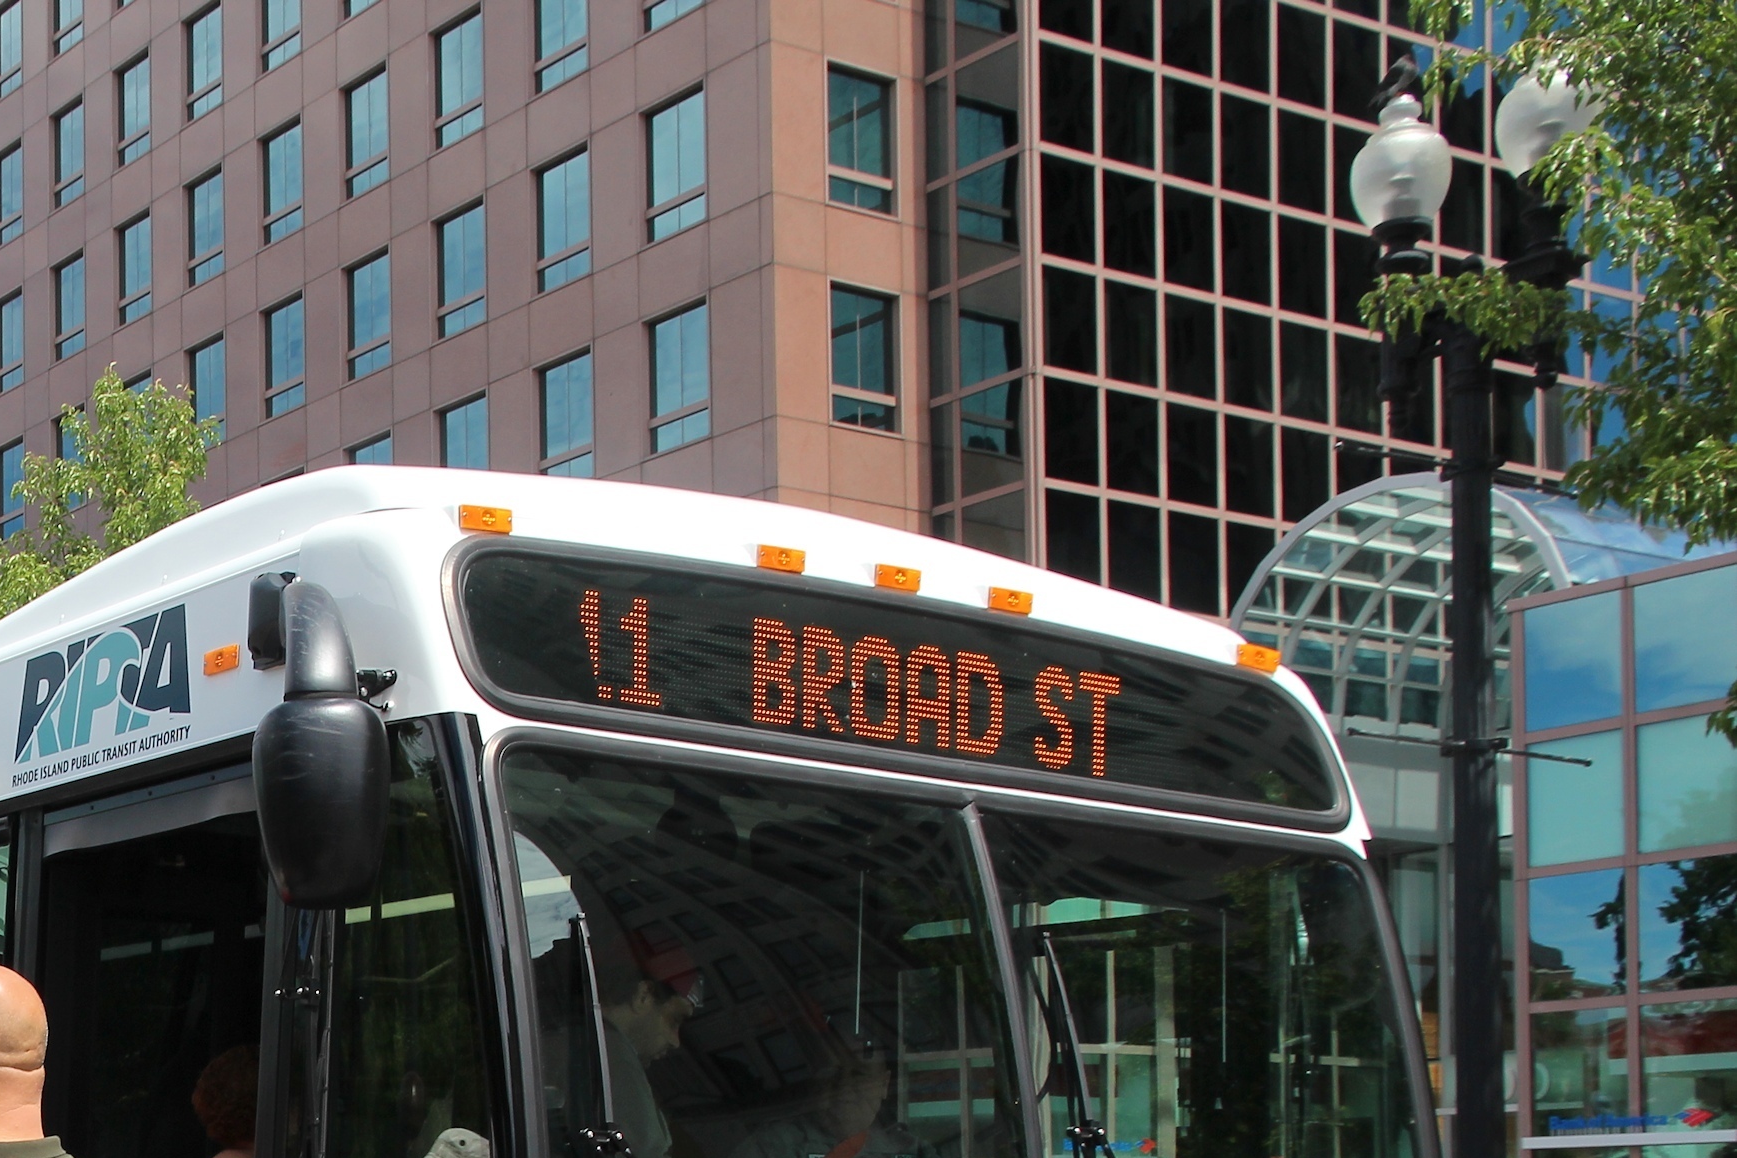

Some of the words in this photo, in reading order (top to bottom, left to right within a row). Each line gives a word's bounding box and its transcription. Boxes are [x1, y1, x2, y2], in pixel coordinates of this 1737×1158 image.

[752, 616, 1004, 757] BROAD
[1034, 664, 1121, 778] ST
[12, 768, 38, 788] RHODE
[40, 760, 69, 779] ISLAND
[71, 751, 100, 770] PUBLIC
[102, 740, 138, 762] TRANSIT
[138, 725, 191, 752] AUTHORITY
